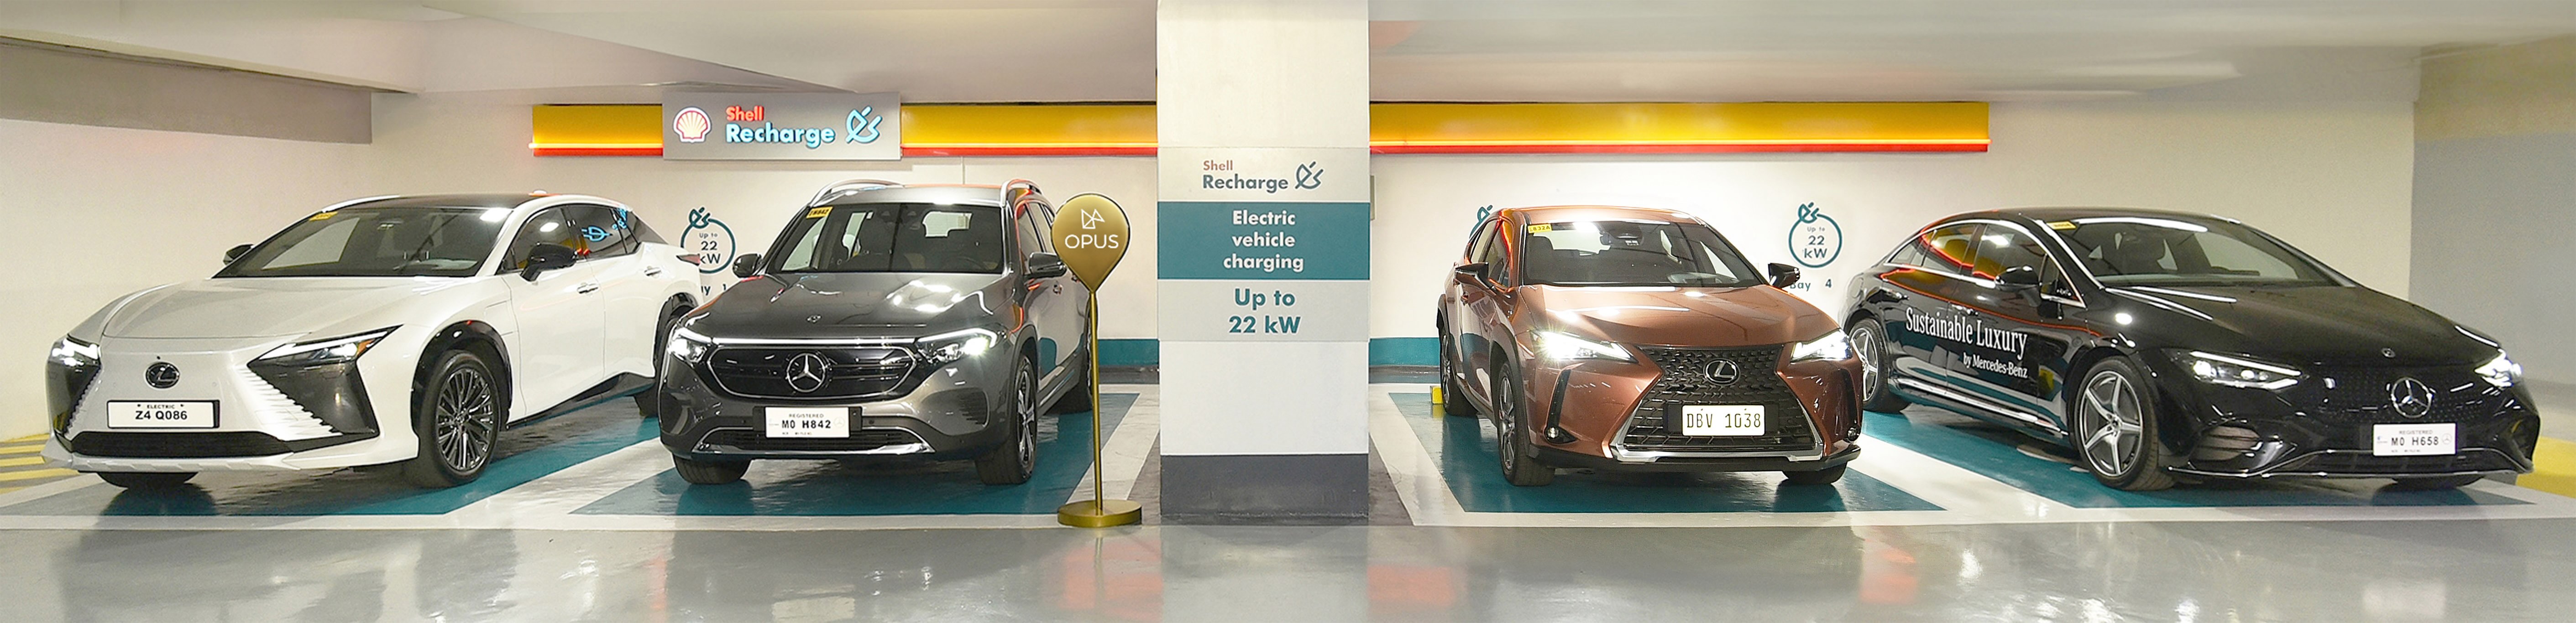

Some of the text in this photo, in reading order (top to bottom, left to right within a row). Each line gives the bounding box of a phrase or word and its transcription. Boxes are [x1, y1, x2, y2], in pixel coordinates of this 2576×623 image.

[726, 105, 764, 122] Shell
[726, 122, 836, 149] Recharge
[1203, 160, 1233, 171] Shell
[1203, 173, 1288, 193] Recharge
[1233, 210, 1296, 225] Electric
[701, 241, 717, 251] 22
[1065, 234, 1119, 249] OPUS
[1232, 232, 1296, 247] vehicle
[1808, 235, 1825, 245] 22
[1804, 248, 1827, 259] kW
[1223, 254, 1304, 273] charging
[1825, 279, 1832, 288] 4
[1234, 288, 1296, 310] Up to
[1229, 315, 1301, 333] 22 kW
[1906, 306, 2028, 360] Sustainable Luxury
[1963, 352, 2028, 379] by Mercedes-Benz
[135, 410, 188, 421] Z4 Q086
[1686, 414, 1761, 428] DBV 1038
[802, 420, 831, 429] H842
[2412, 436, 2439, 446] H658
